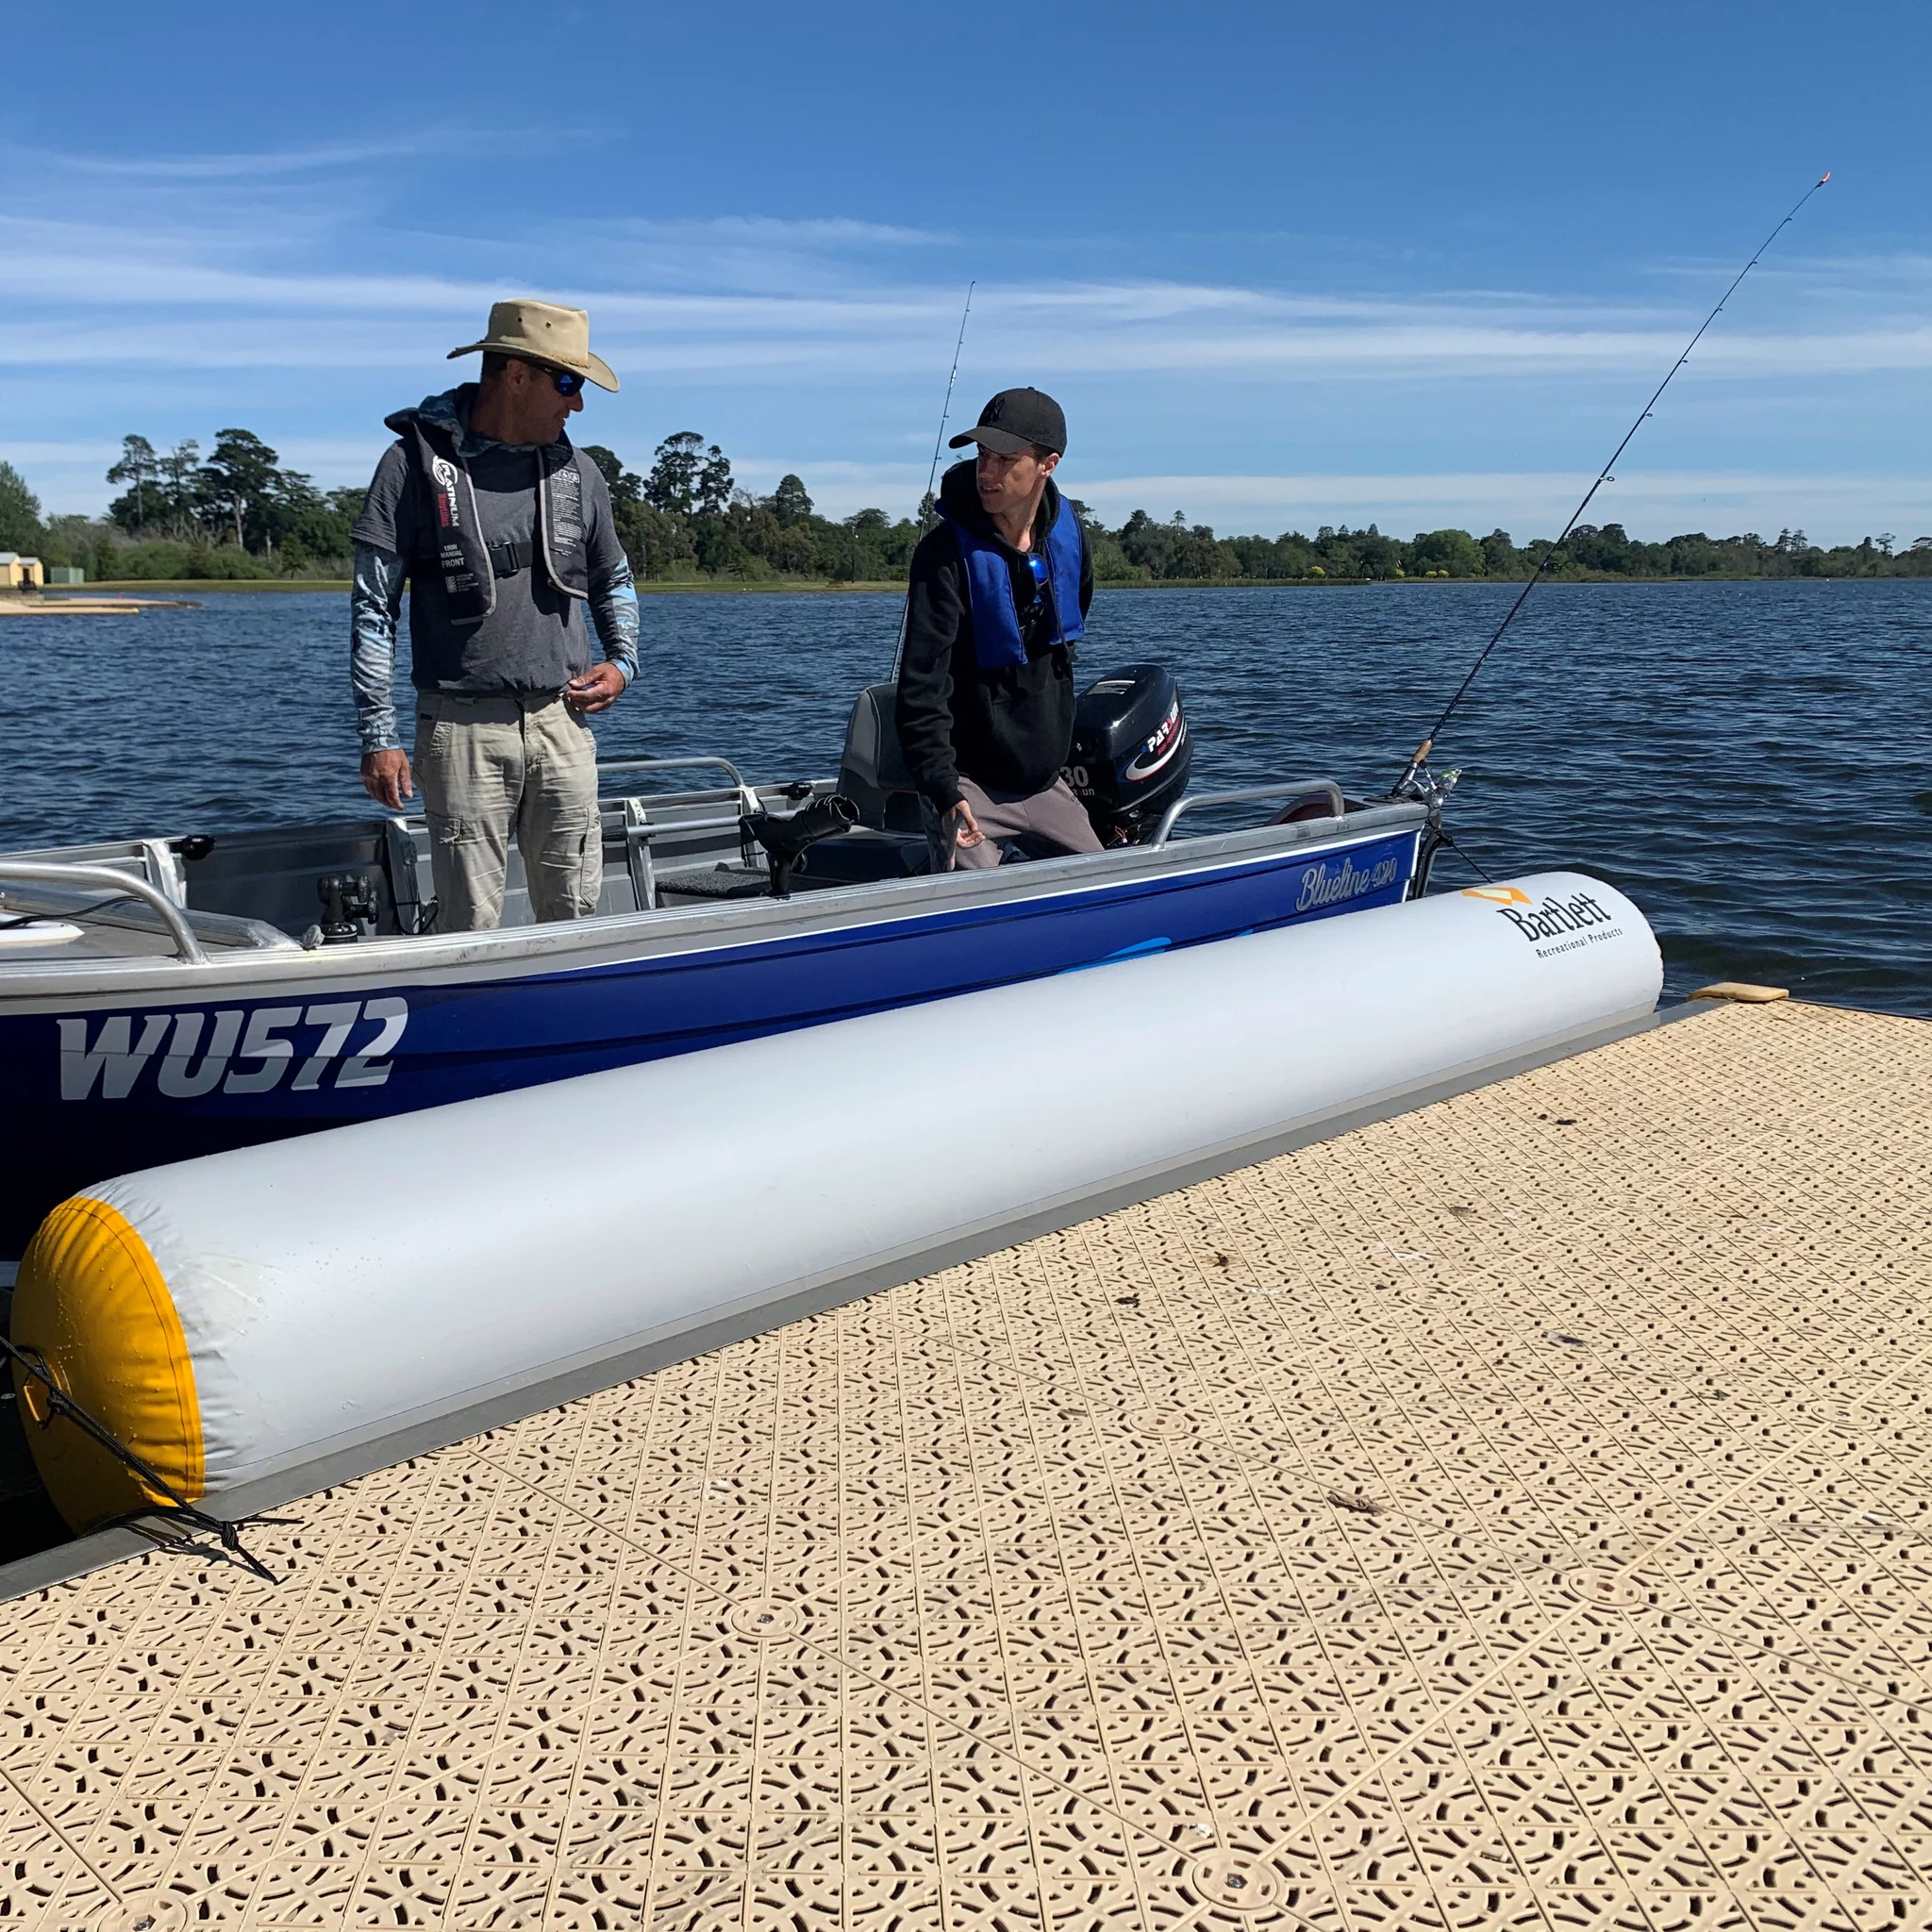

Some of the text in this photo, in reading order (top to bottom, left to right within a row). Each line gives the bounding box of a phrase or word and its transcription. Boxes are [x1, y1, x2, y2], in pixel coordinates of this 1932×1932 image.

[441, 464, 460, 527] PLATINUM
[441, 557, 465, 569] FRONT
[1059, 765, 1089, 788] 30
[1295, 857, 1398, 912] Blueline 420
[1495, 891, 1612, 942] Bartlett
[1535, 927, 1624, 959] Recreational Products
[56, 995, 409, 1101] WU572
